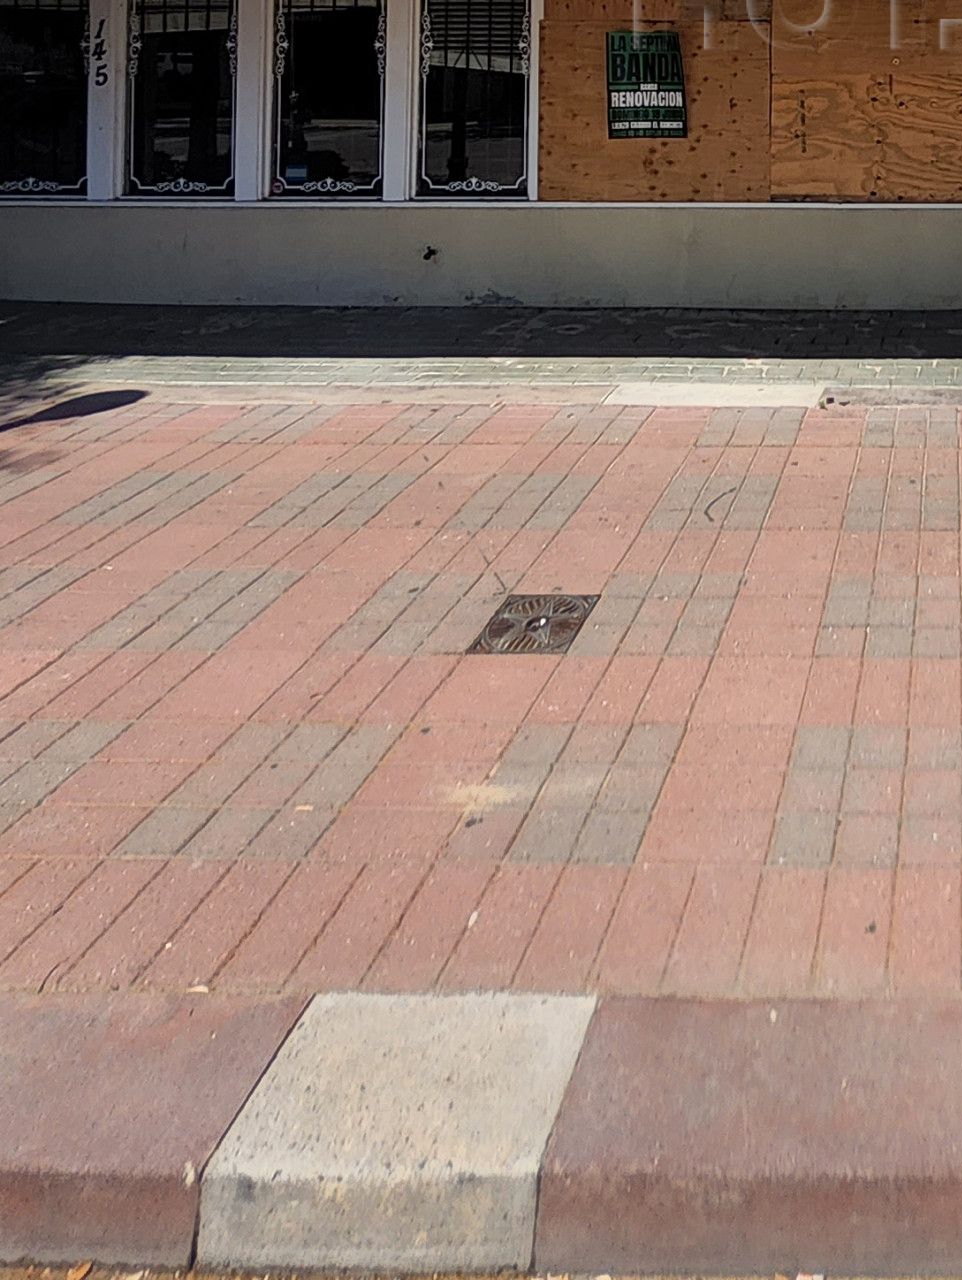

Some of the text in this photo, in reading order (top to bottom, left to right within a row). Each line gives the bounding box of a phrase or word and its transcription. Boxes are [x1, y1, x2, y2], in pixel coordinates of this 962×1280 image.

[92, 19, 108, 87] 145
[611, 35, 626, 51] LA
[611, 53, 683, 81] BANDA
[611, 92, 683, 107] RENOVACION
